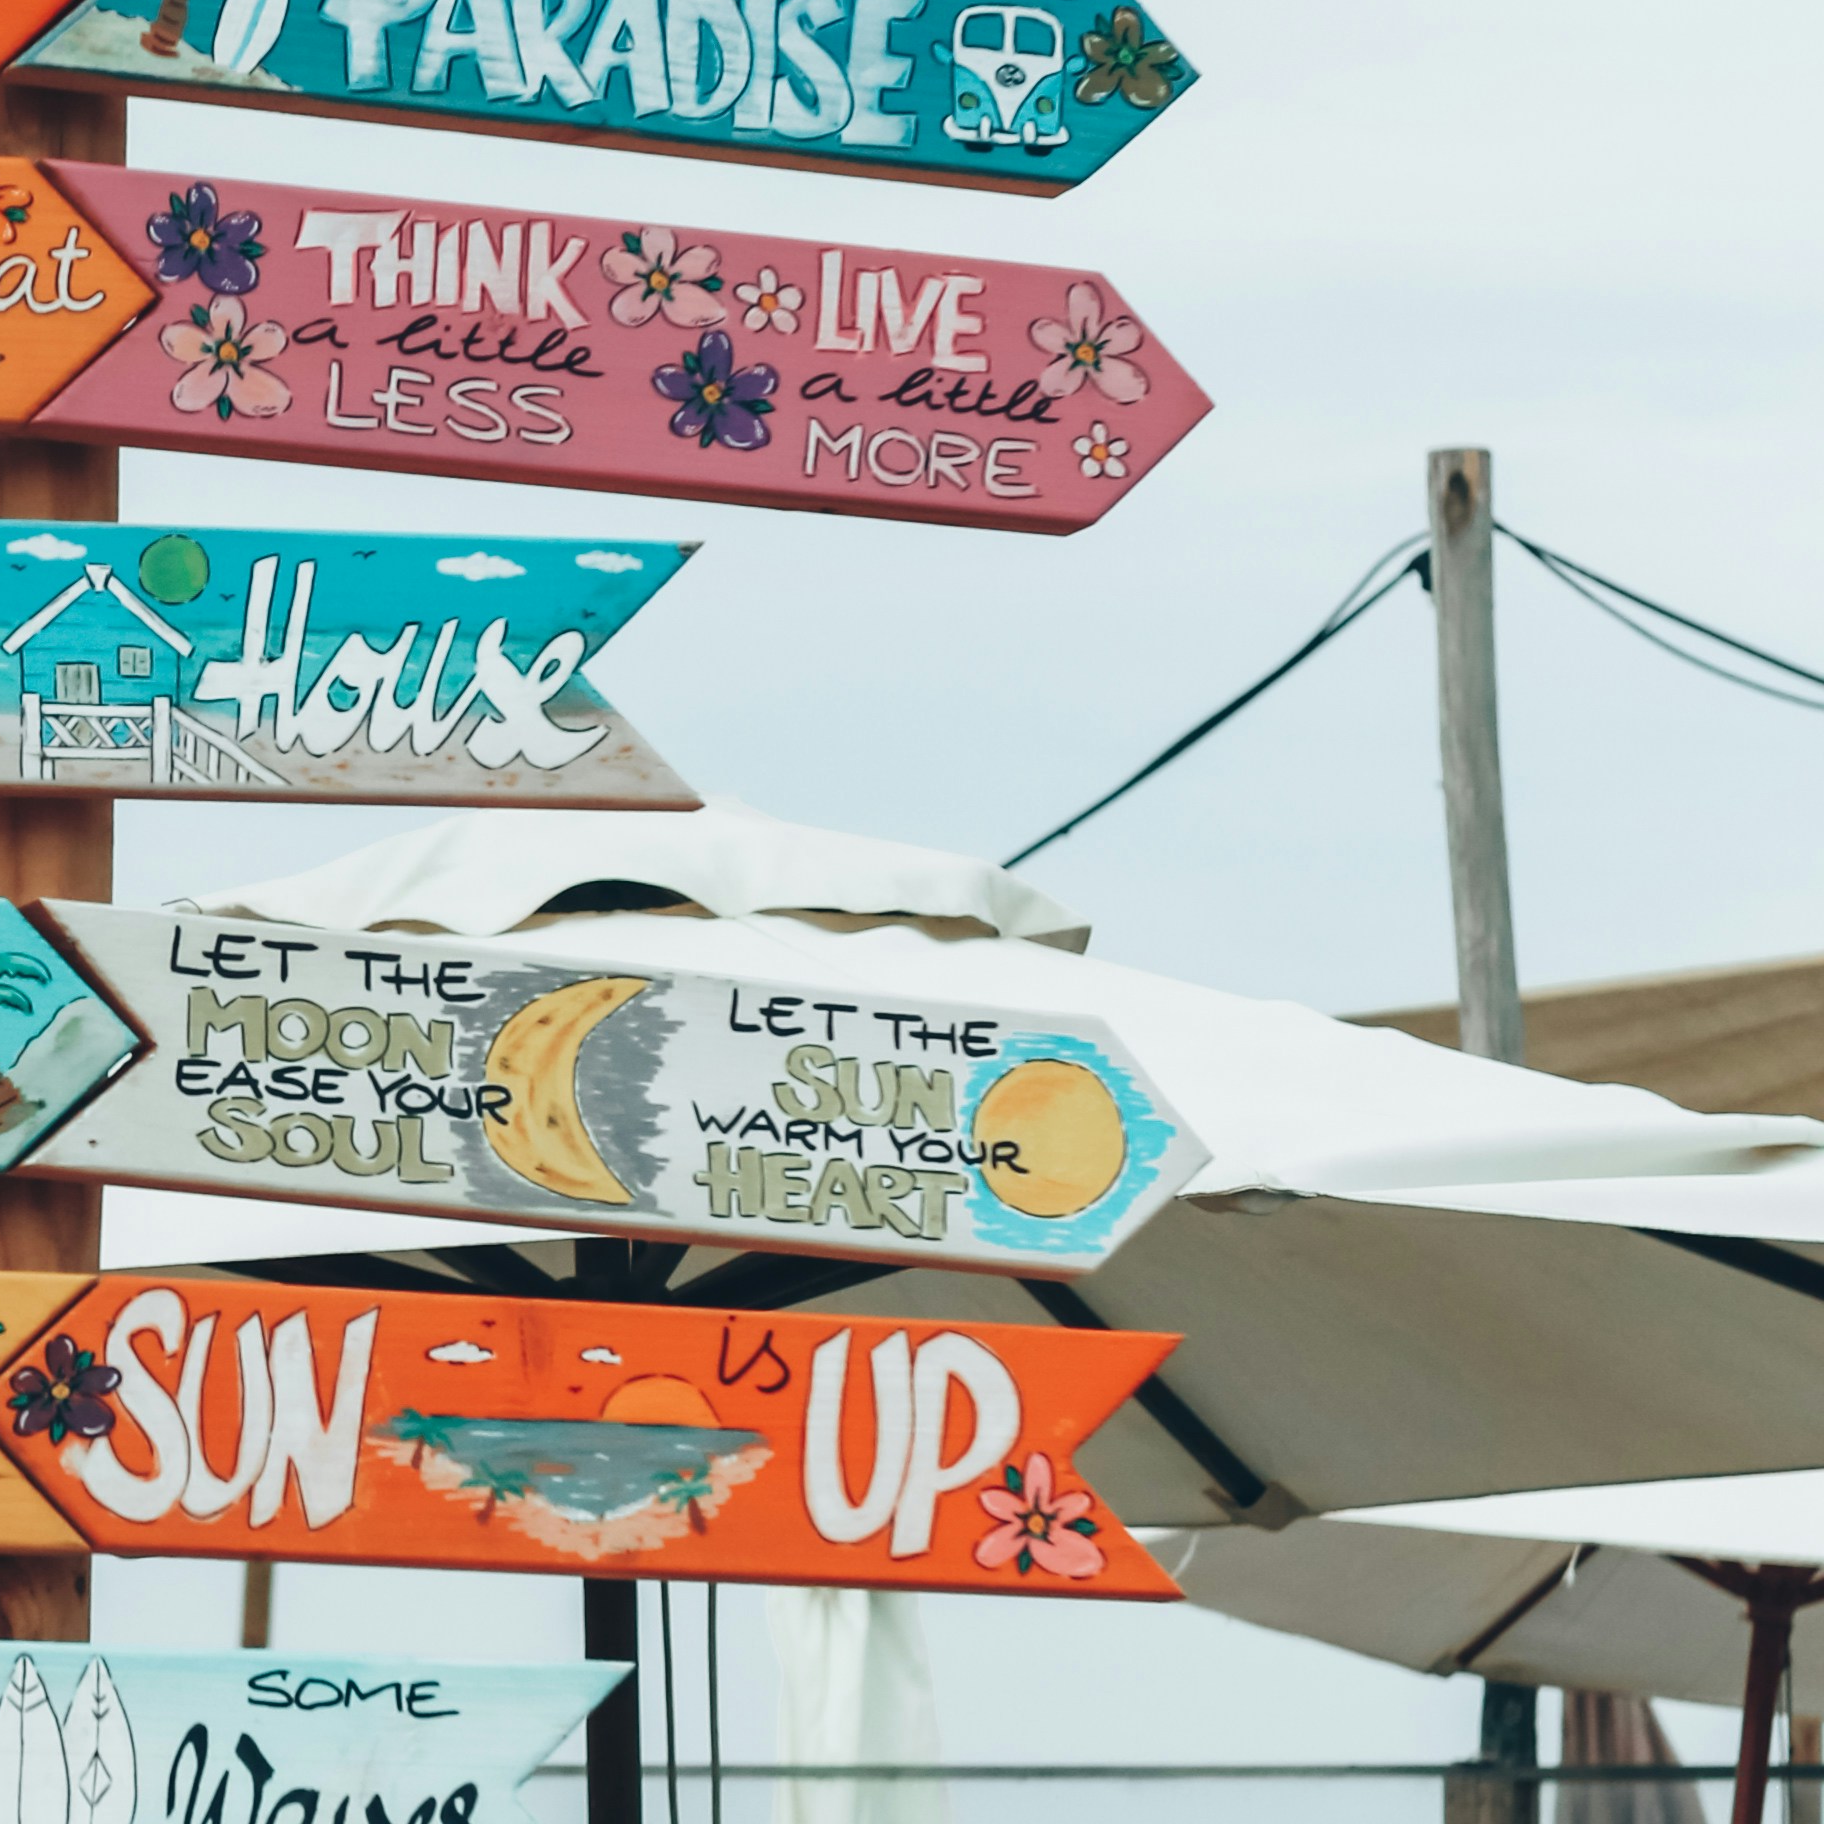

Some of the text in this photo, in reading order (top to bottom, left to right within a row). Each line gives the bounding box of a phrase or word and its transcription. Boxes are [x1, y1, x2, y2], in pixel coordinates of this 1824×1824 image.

[296, 209, 587, 327] THINK
[292, 312, 606, 380] a little
[814, 250, 991, 374] LIVE
[324, 363, 575, 449] LESS
[799, 366, 1066, 426] a little
[802, 422, 1039, 500] MORE
[194, 553, 611, 773] House
[170, 924, 487, 1005] LET THE
[186, 986, 455, 1083] MOON
[728, 988, 1001, 1058] LET THE
[174, 1057, 515, 1125] EASE YOUR
[772, 1042, 958, 1132] SUN
[195, 1098, 455, 1185] SOUL
[691, 1098, 1032, 1176] WARM YOUR
[694, 1140, 971, 1241] HEART
[77, 1286, 1022, 1561] SUN is UP
[245, 1669, 462, 1718] SOME
